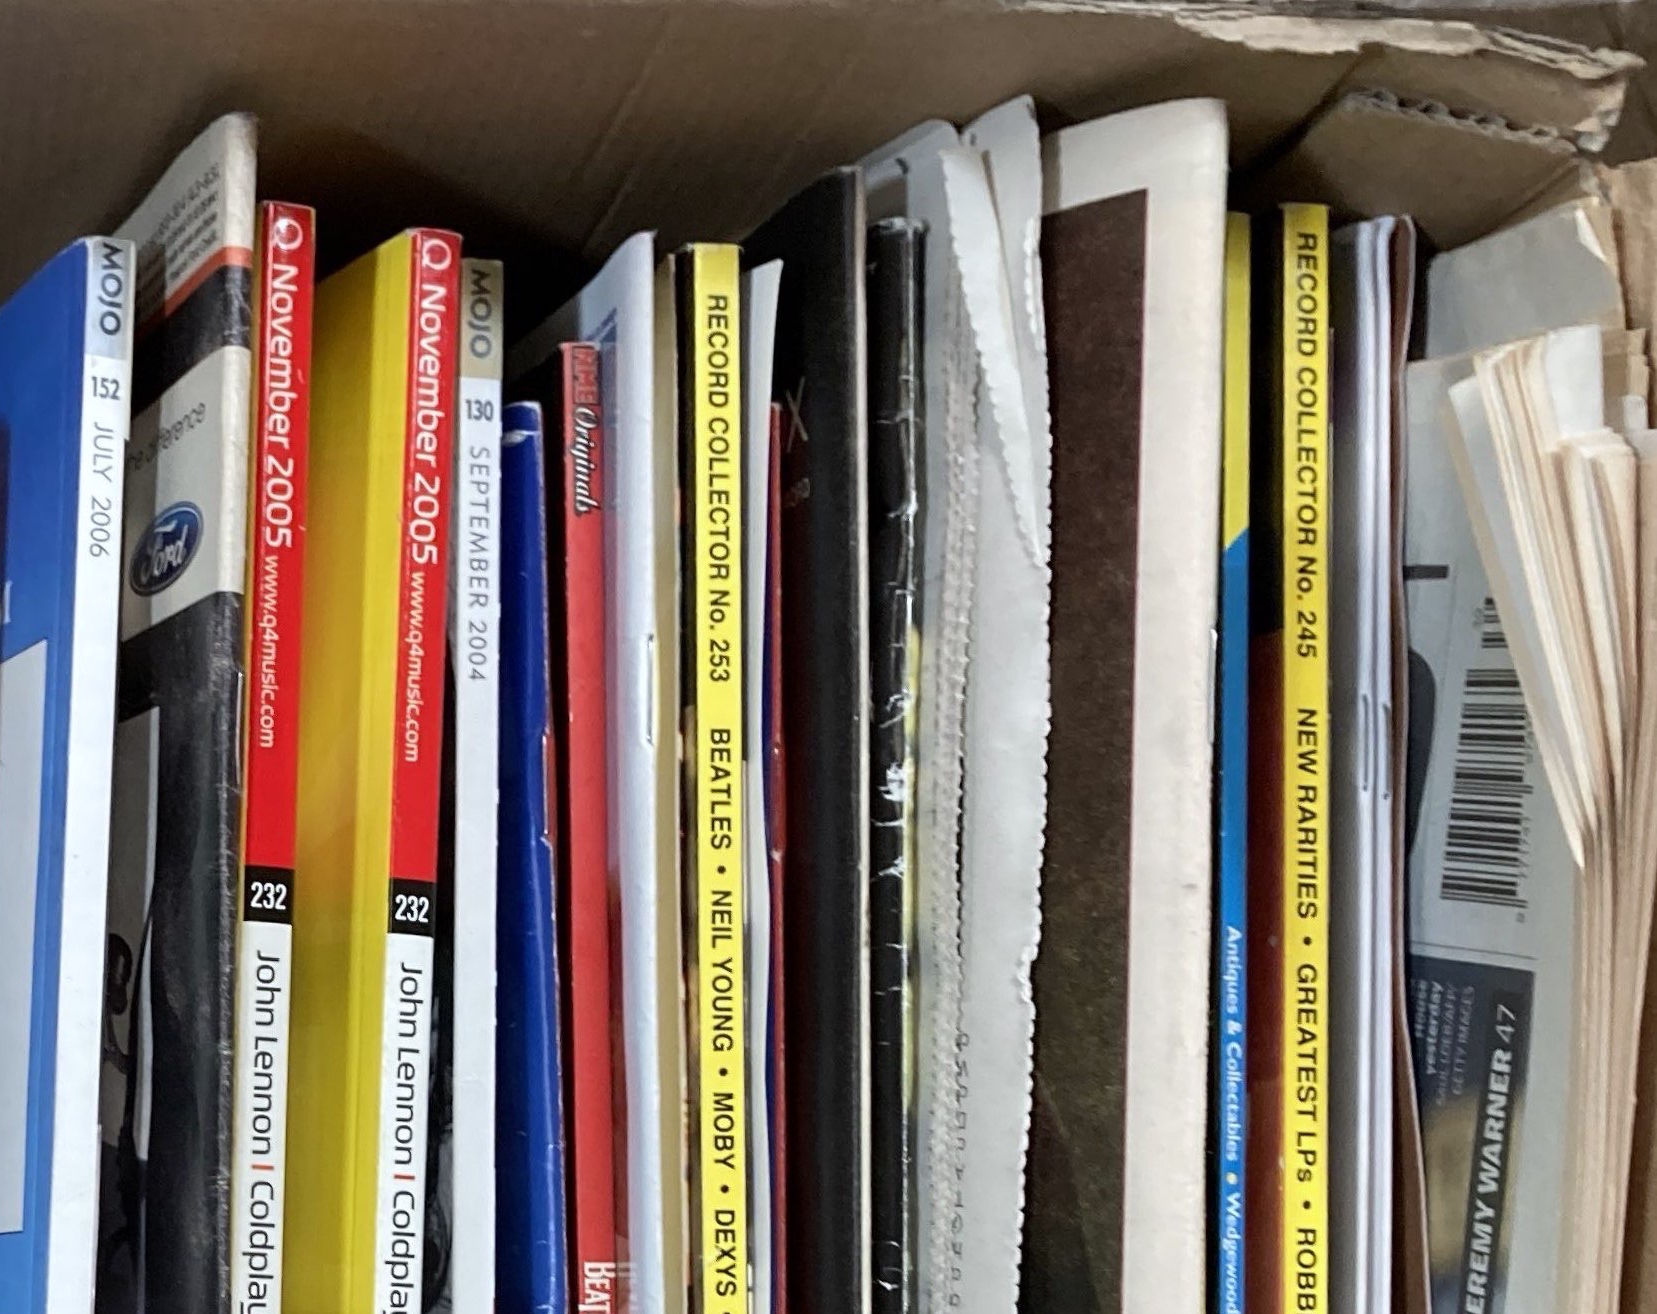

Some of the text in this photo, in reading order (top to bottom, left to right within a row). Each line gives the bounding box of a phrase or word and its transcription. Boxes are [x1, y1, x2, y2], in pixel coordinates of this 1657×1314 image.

[99, 242, 124, 335] MOJO
[1296, 231, 1318, 356] RECORD
[92, 376, 119, 400] 152
[413, 284, 446, 466] November
[708, 295, 728, 407] RECORD
[90, 422, 113, 557] JULY 2006
[569, 406, 597, 514] Originals
[709, 418, 729, 579] COLLECTOR
[1297, 368, 1317, 545] COLLECTOR
[409, 473, 440, 564] 2005
[710, 590, 730, 629] No.
[1297, 556, 1317, 599] No.
[405, 572, 424, 761] www.q4music.com
[710, 639, 730, 681] 253
[1297, 611, 1316, 657] 245
[1298, 709, 1317, 774] NEW
[711, 729, 731, 849] BEATLES
[1297, 785, 1317, 918] RARITIES
[395, 895, 429, 922] 232
[712, 891, 732, 948] NEIL
[399, 962, 423, 1037] John
[712, 958, 733, 1051] YOUNG
[1223, 926, 1242, 1013] Antiques
[1227, 1020, 1241, 1035] &
[1297, 964, 1317, 1121] GREATEST
[395, 1048, 419, 1164] Lennon
[714, 1093, 734, 1169] MOBY
[1226, 1042, 1242, 1161] Collectables
[1477, 1050, 1512, 1193] WARNER
[1496, 1005, 1515, 1042] 47
[1297, 1132, 1316, 1182] LPs
[715, 1210, 736, 1296] DEXYS
